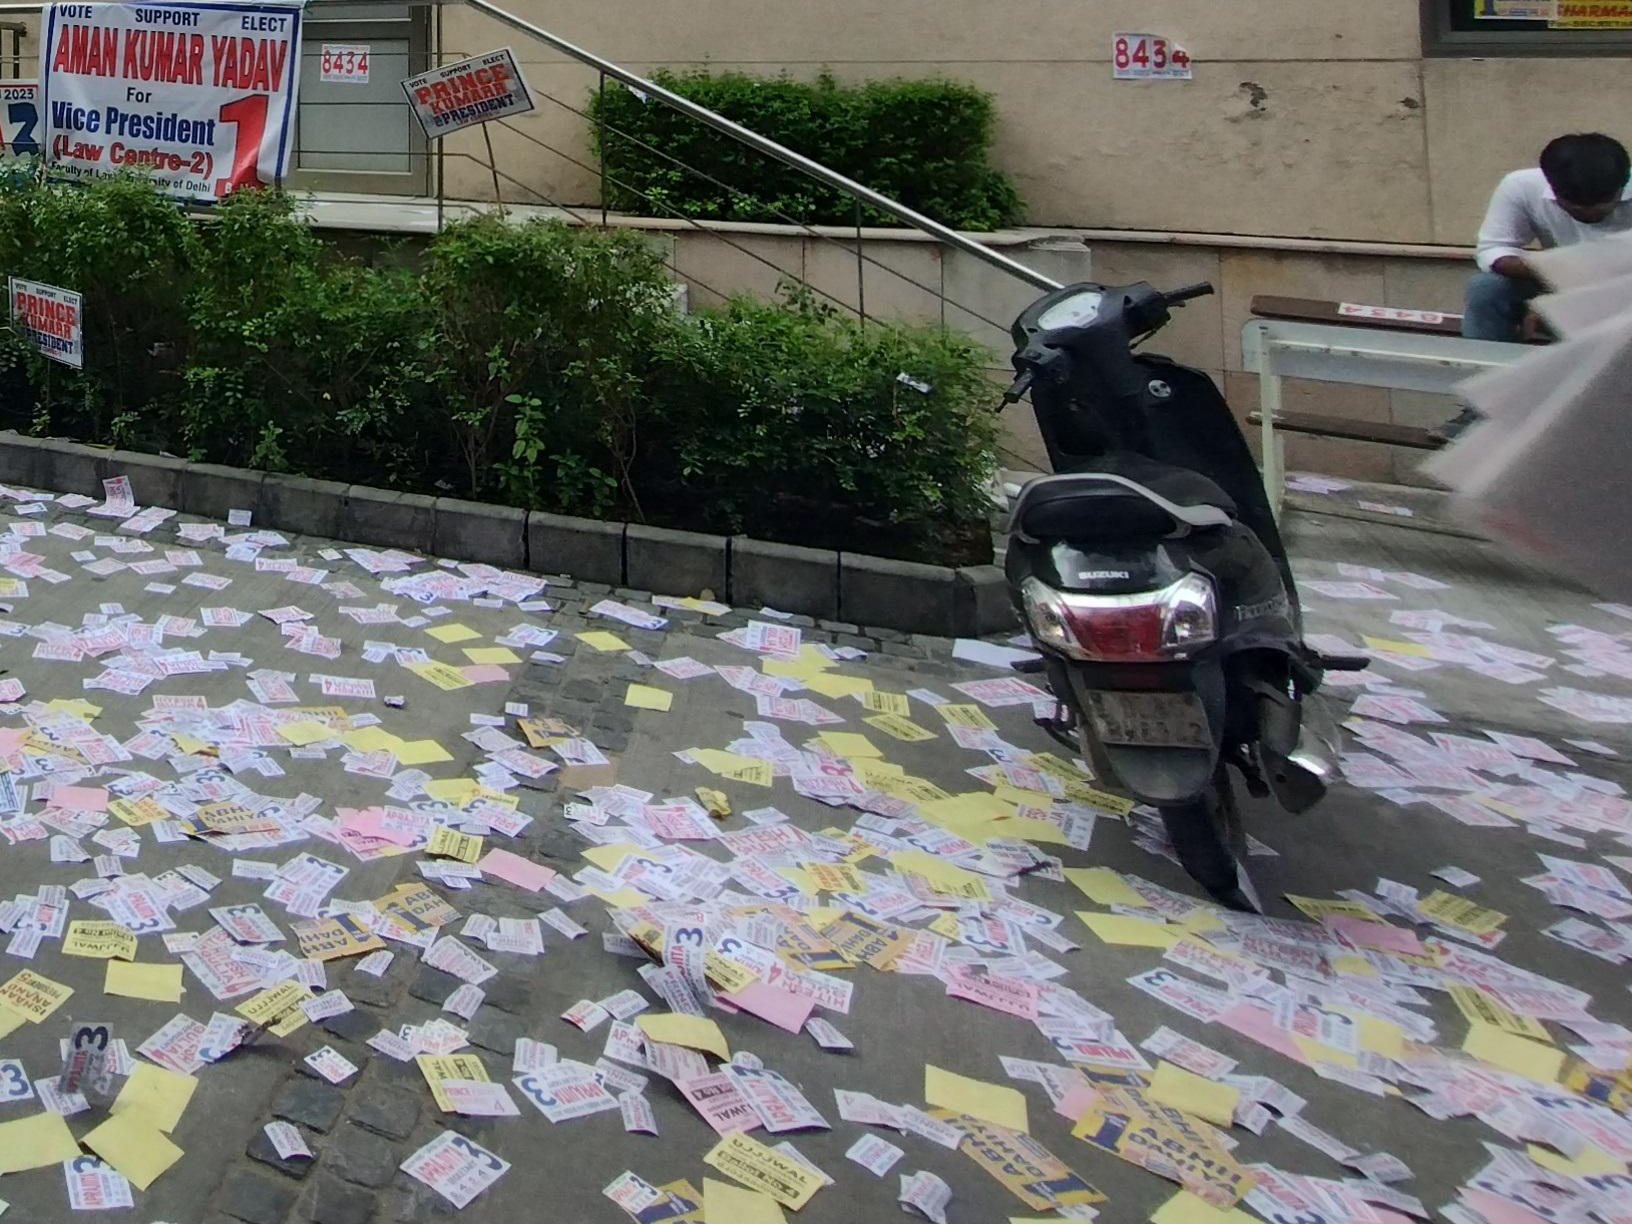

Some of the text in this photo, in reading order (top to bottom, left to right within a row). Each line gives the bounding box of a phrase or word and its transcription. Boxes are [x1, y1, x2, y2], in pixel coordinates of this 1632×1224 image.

[59, 4, 287, 32] VOTE SUPPORT ELECT
[52, 24, 288, 93] AMAN KUMAR YADAV
[322, 50, 368, 75] 8434
[1113, 38, 1190, 70] 8434
[4, 88, 34, 100] 2023
[126, 87, 152, 103] For
[415, 62, 512, 106] PRINCE
[51, 101, 215, 146] Vice President
[441, 93, 515, 127] PRESIDENT
[52, 134, 104, 161] (Law
[110, 141, 214, 180] Centre-2)
[214, 93, 270, 198] 1
[185, 180, 211, 192] Delhi
[15, 291, 76, 326] PRINCE
[1078, 571, 1129, 579] SUZUKI
[74, 1026, 110, 1052] 3
[0, 1064, 29, 1096] 3
[521, 1077, 557, 1106] 3
[451, 1136, 503, 1171] 3
